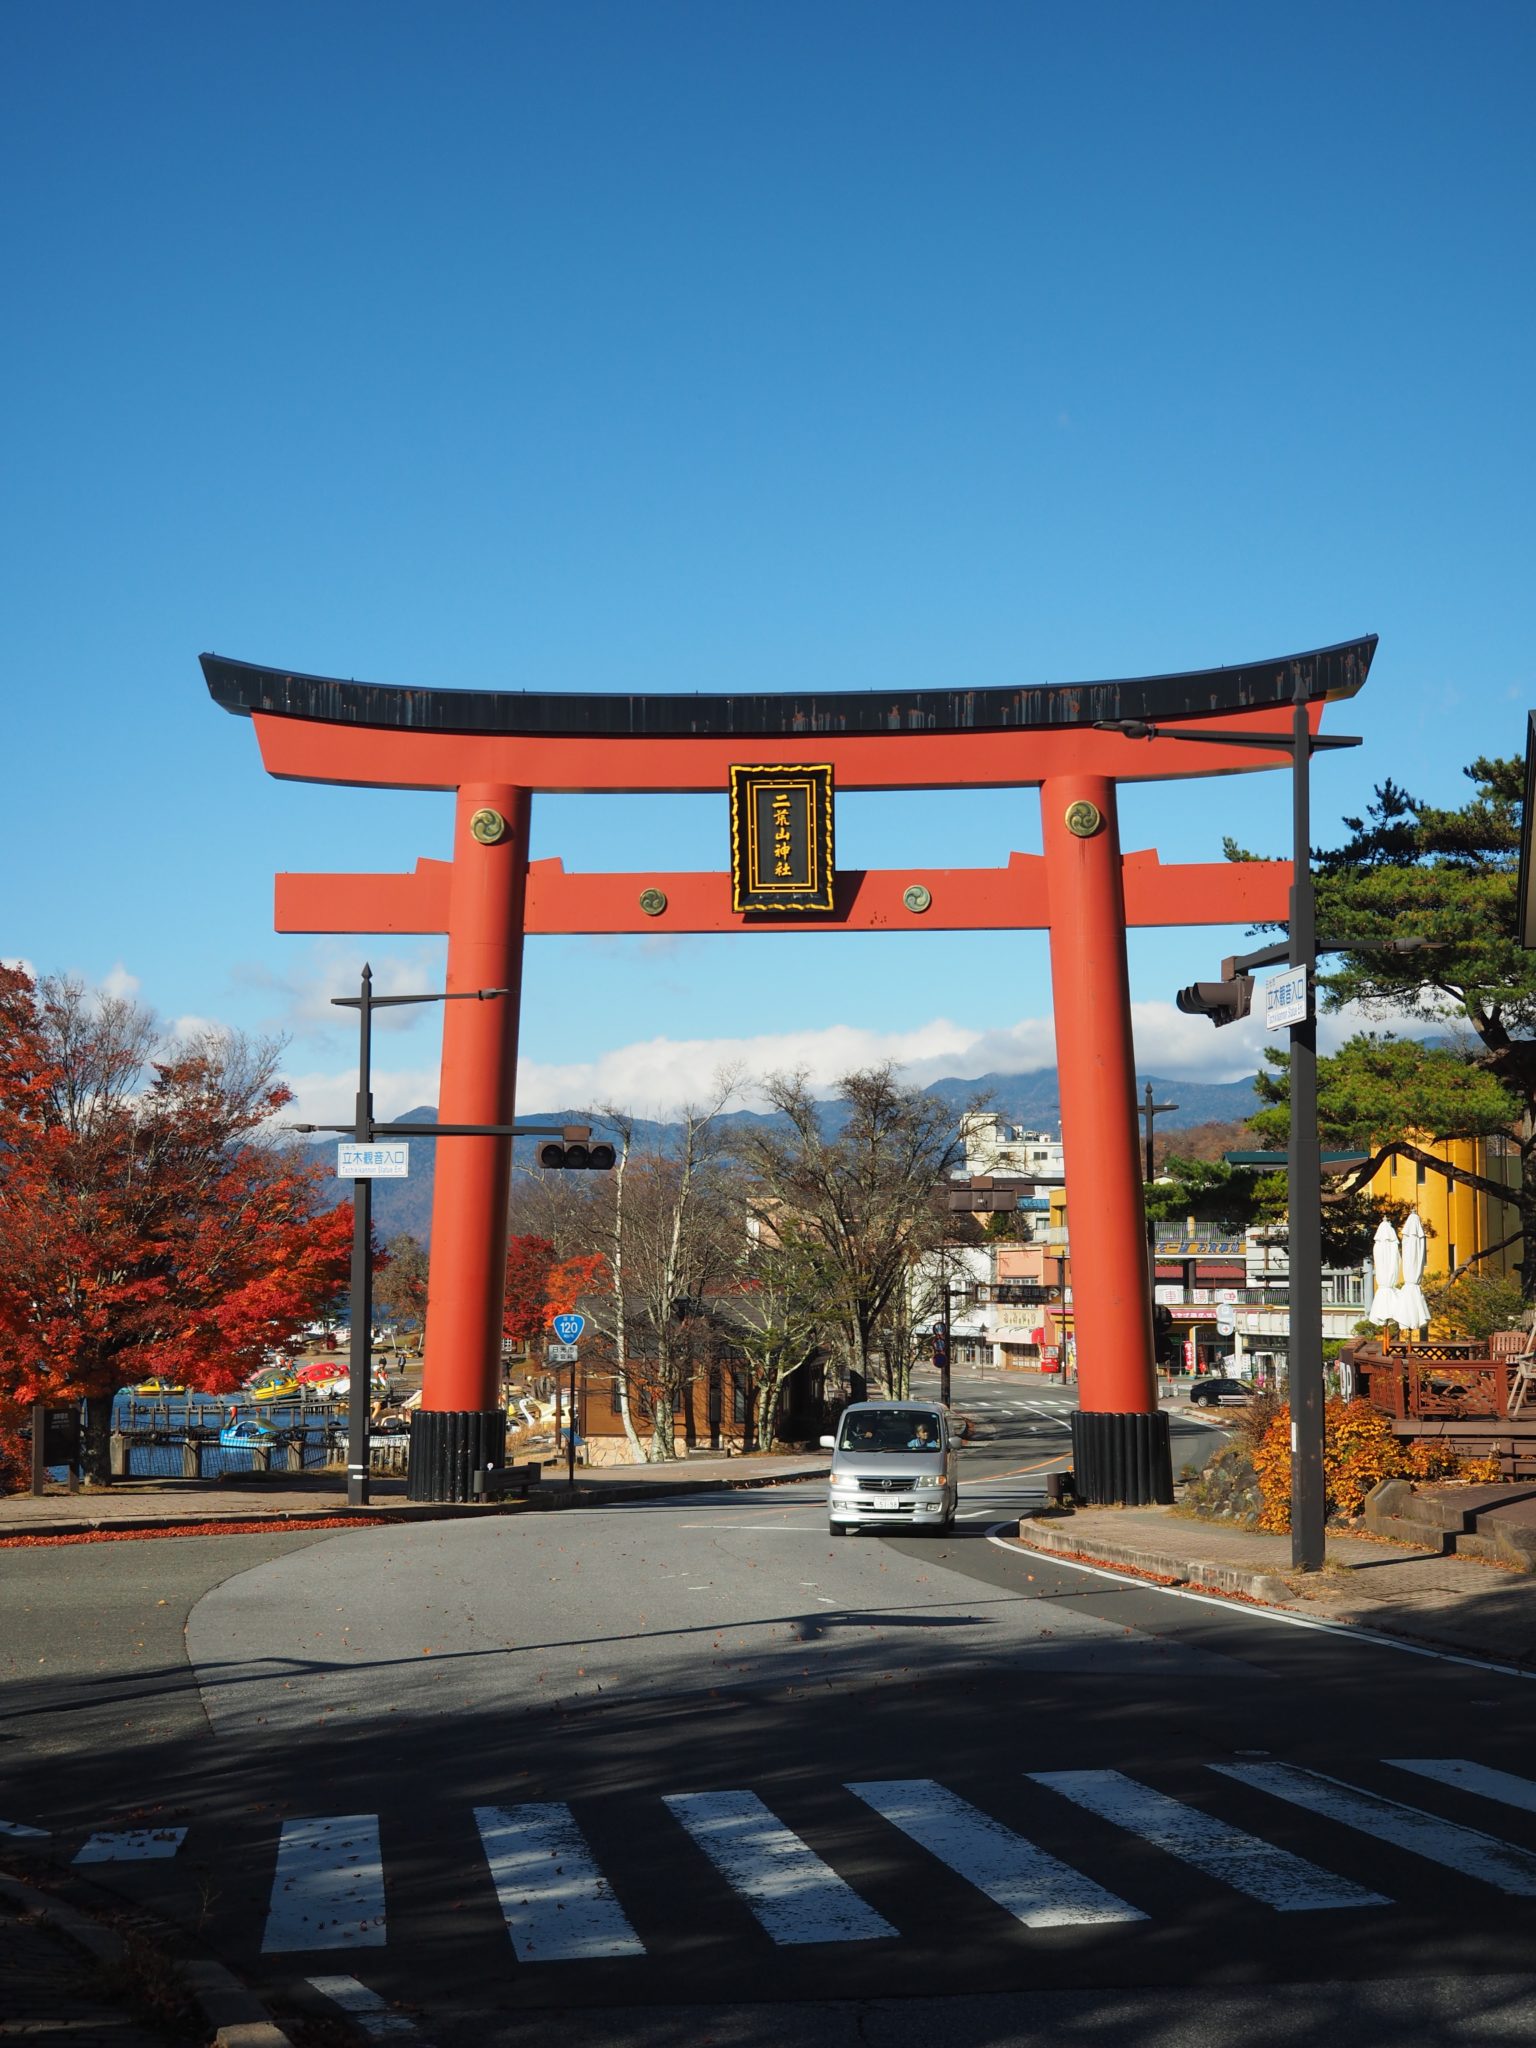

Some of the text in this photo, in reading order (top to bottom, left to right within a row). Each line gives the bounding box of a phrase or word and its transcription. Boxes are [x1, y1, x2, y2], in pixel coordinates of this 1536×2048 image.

[771, 794, 793, 877] 二荒山神社
[1267, 979, 1304, 1010] 立木観音入口
[342, 1150, 405, 1165] 立木観音入口
[560, 1321, 578, 1333] 120
